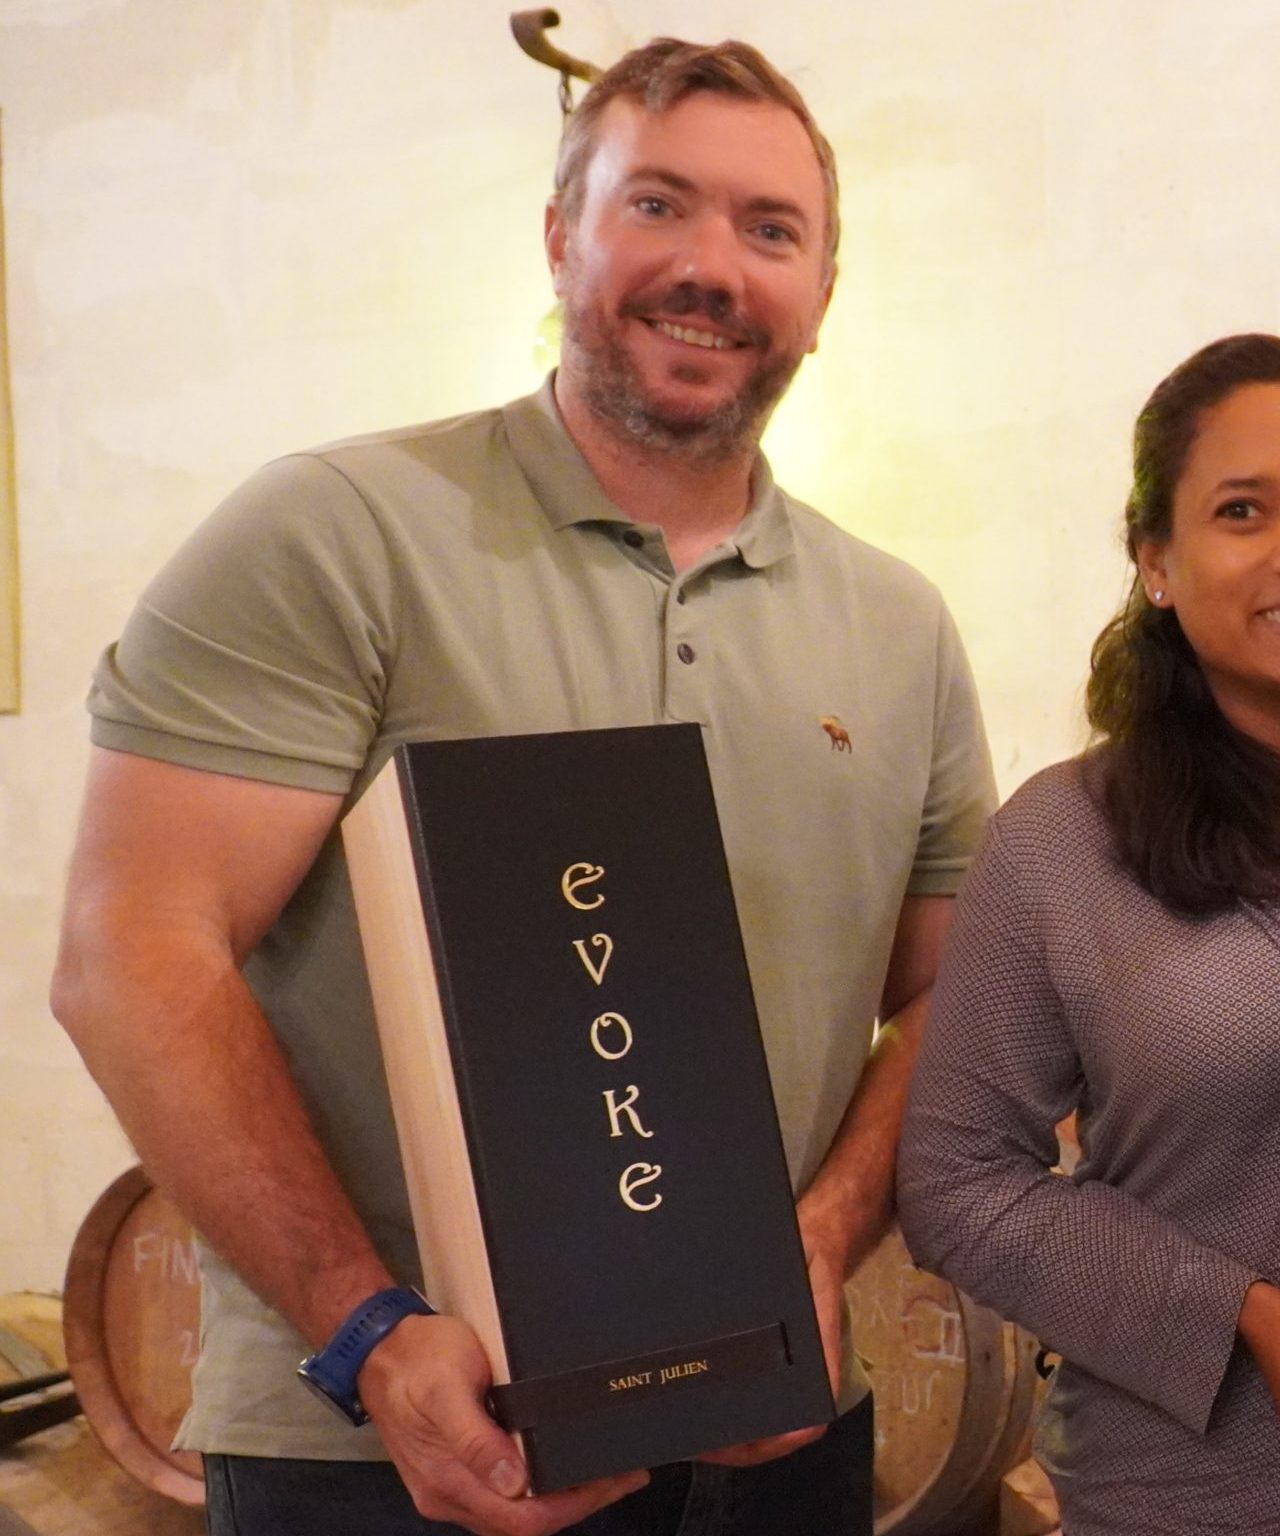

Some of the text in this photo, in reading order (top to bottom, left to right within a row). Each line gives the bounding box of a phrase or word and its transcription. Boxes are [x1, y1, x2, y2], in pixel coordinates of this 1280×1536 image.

[561, 862, 662, 1212] EVOKE
[608, 1360, 708, 1392] SAINT JULIEN
